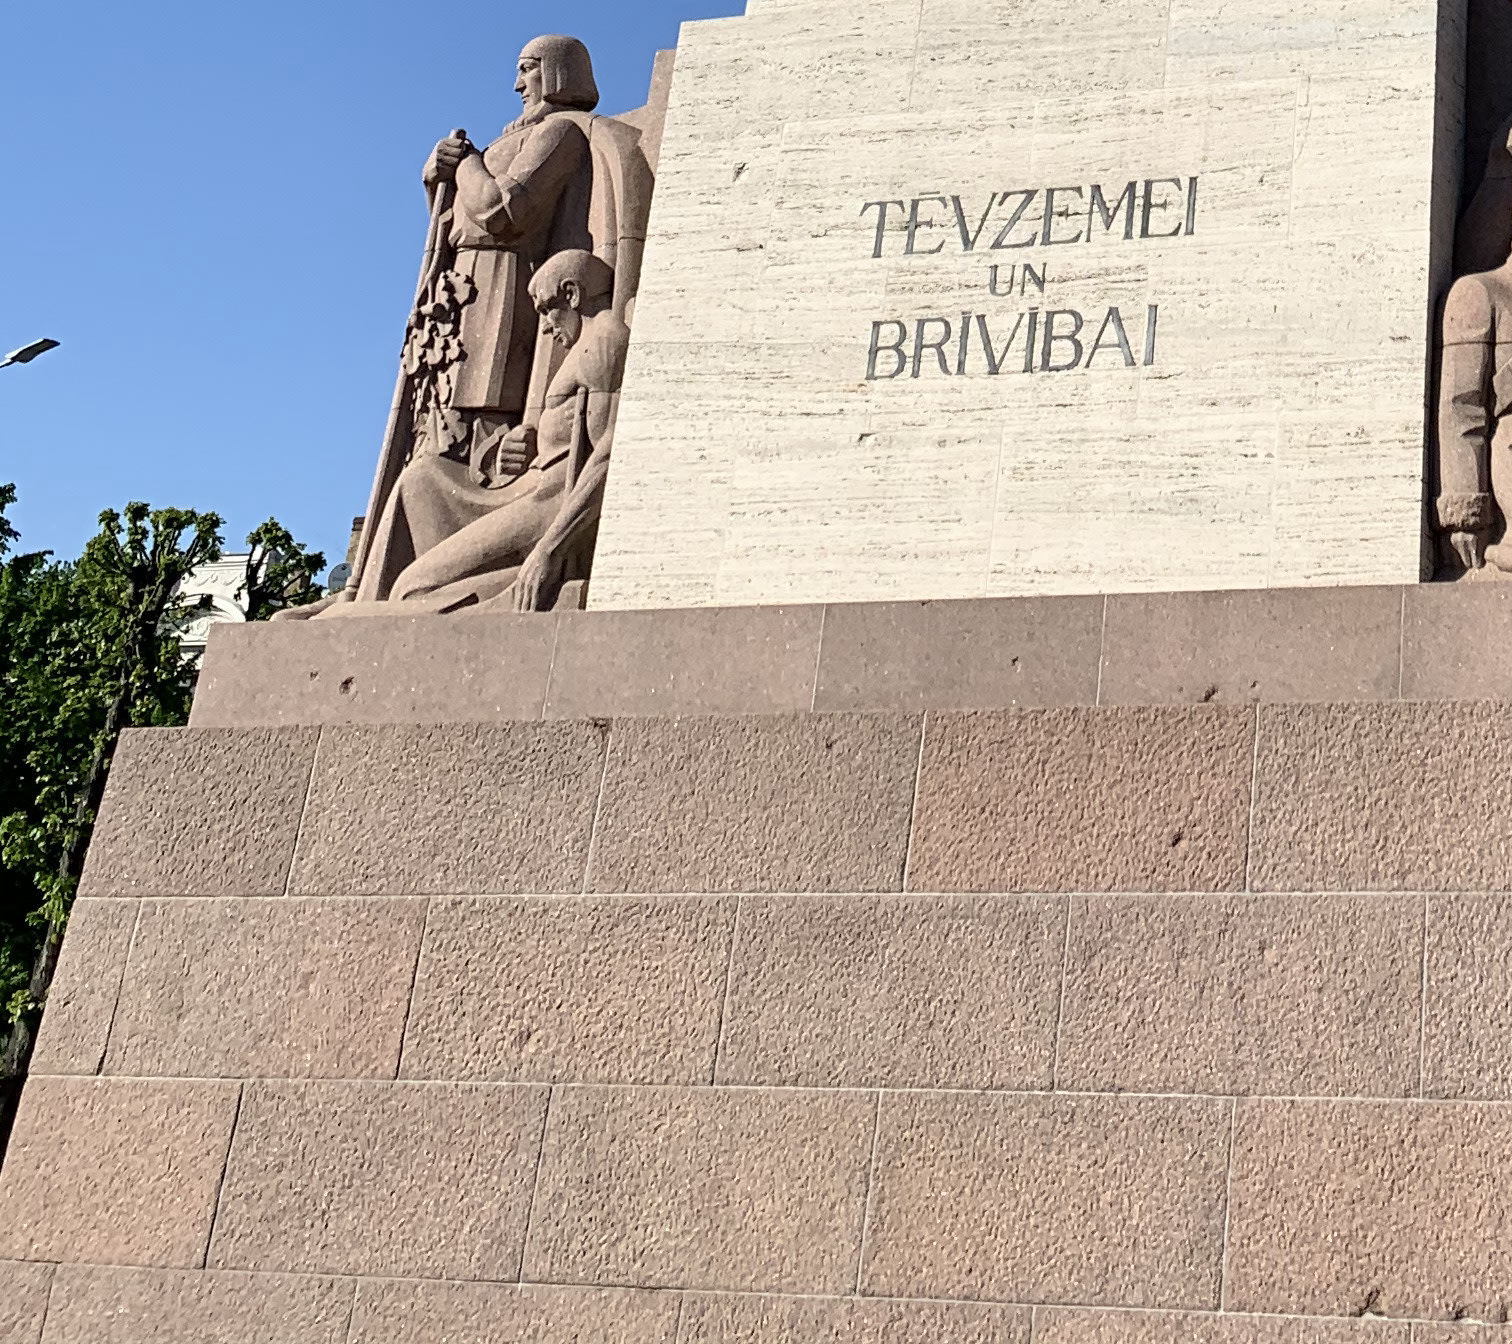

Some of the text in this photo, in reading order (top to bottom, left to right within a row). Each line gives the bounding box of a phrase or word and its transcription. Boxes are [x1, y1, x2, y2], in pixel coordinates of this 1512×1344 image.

[859, 175, 1200, 259] TĒVZEMEI
[988, 262, 1048, 297] UN
[864, 303, 1159, 381] BRĪVĪBAI
